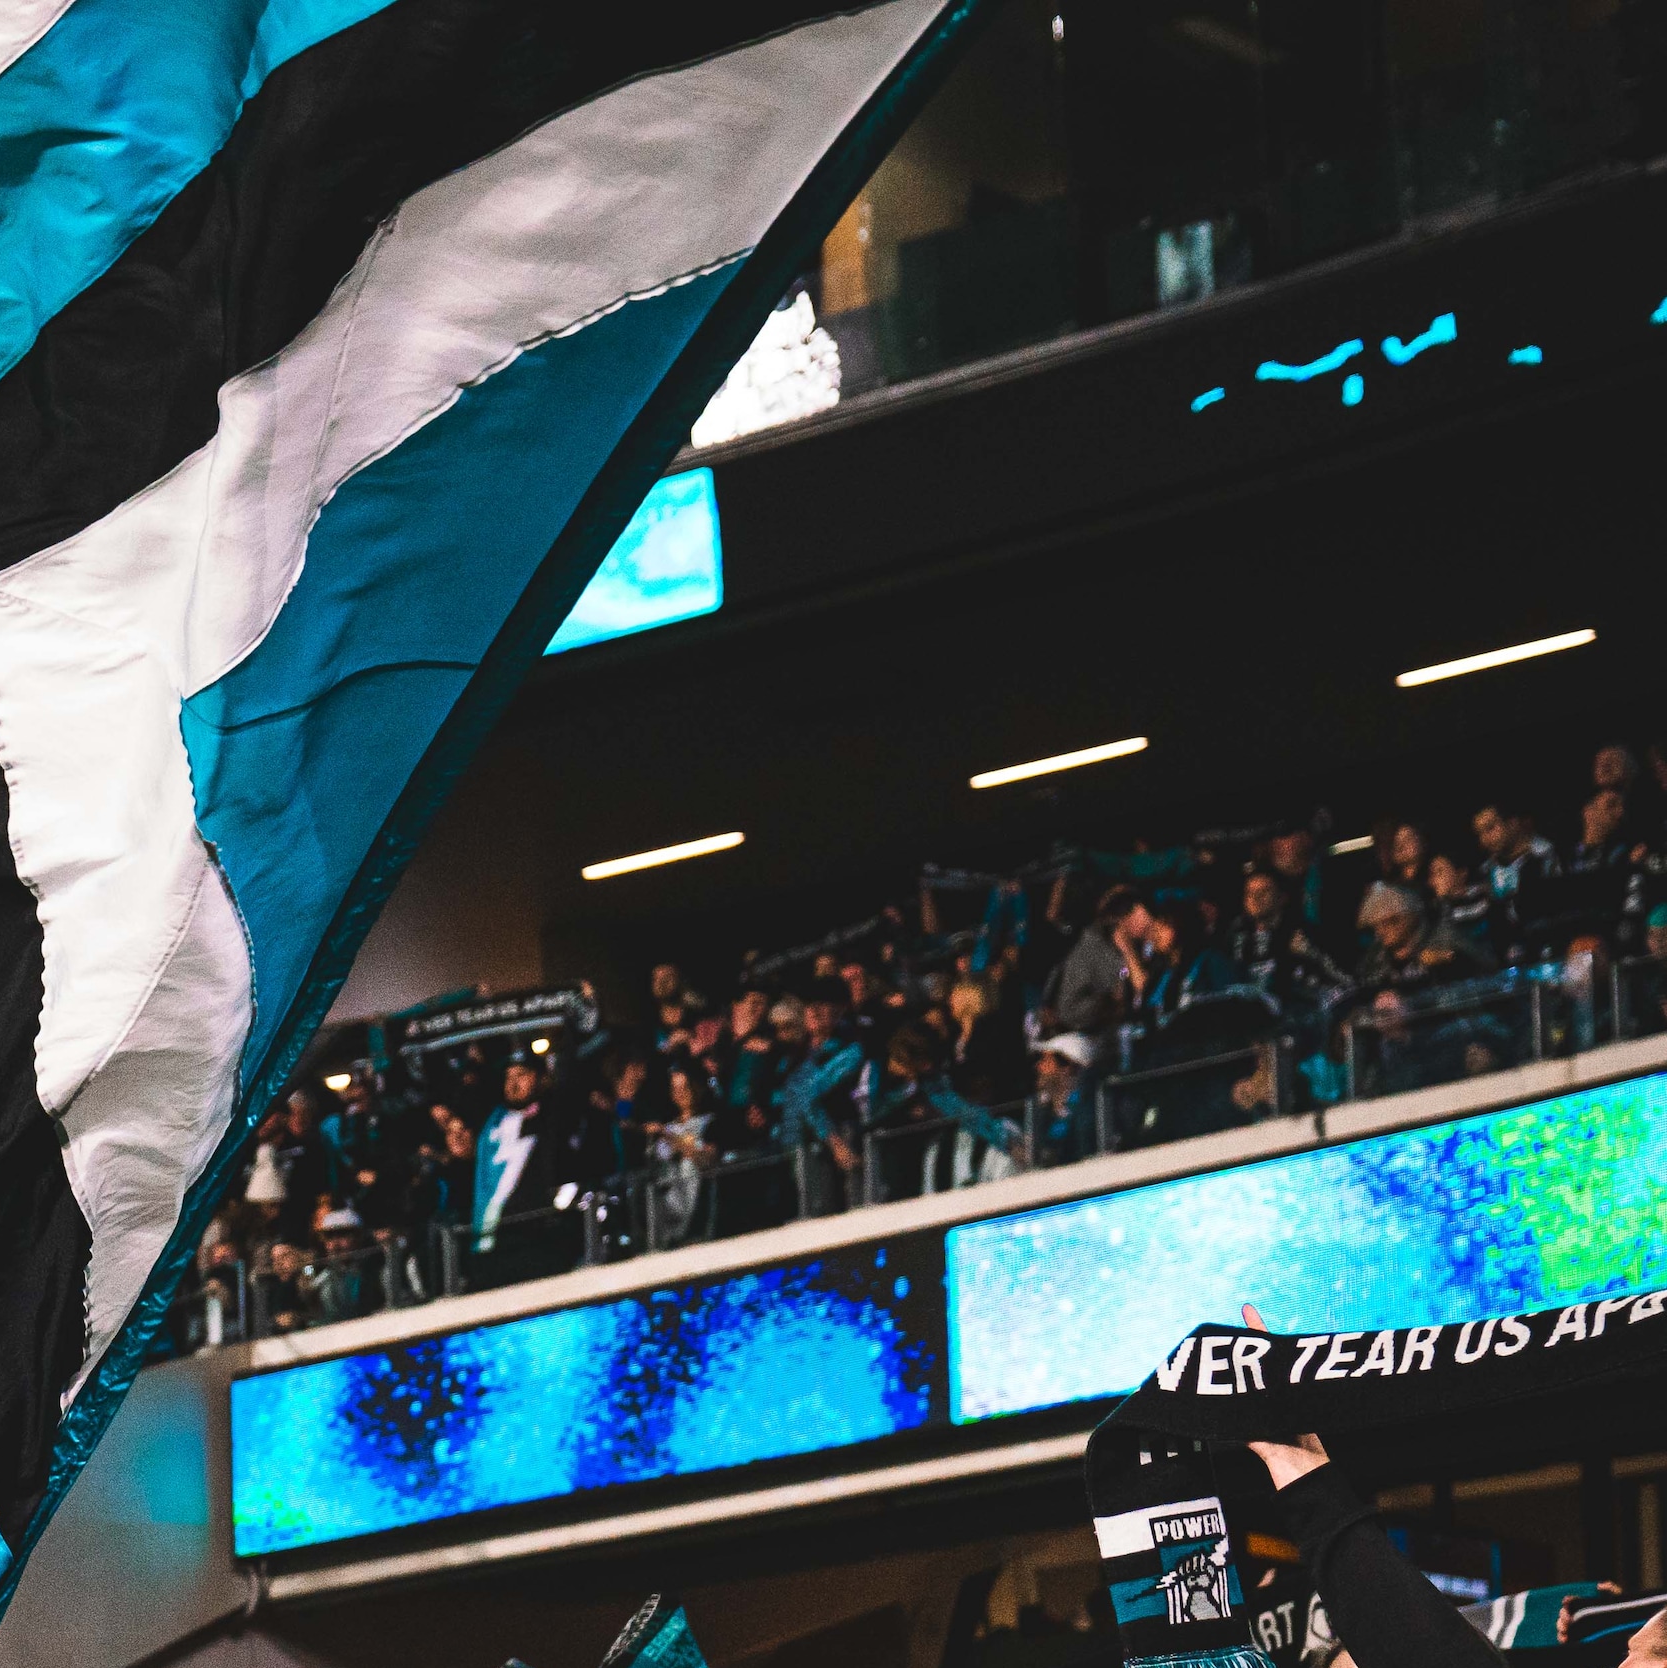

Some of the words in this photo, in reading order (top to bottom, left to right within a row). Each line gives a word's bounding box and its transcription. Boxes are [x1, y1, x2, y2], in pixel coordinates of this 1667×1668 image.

[1289, 1327, 1441, 1383] TEAR
[1454, 1313, 1533, 1365] US
[1154, 1514, 1220, 1543] POWER
